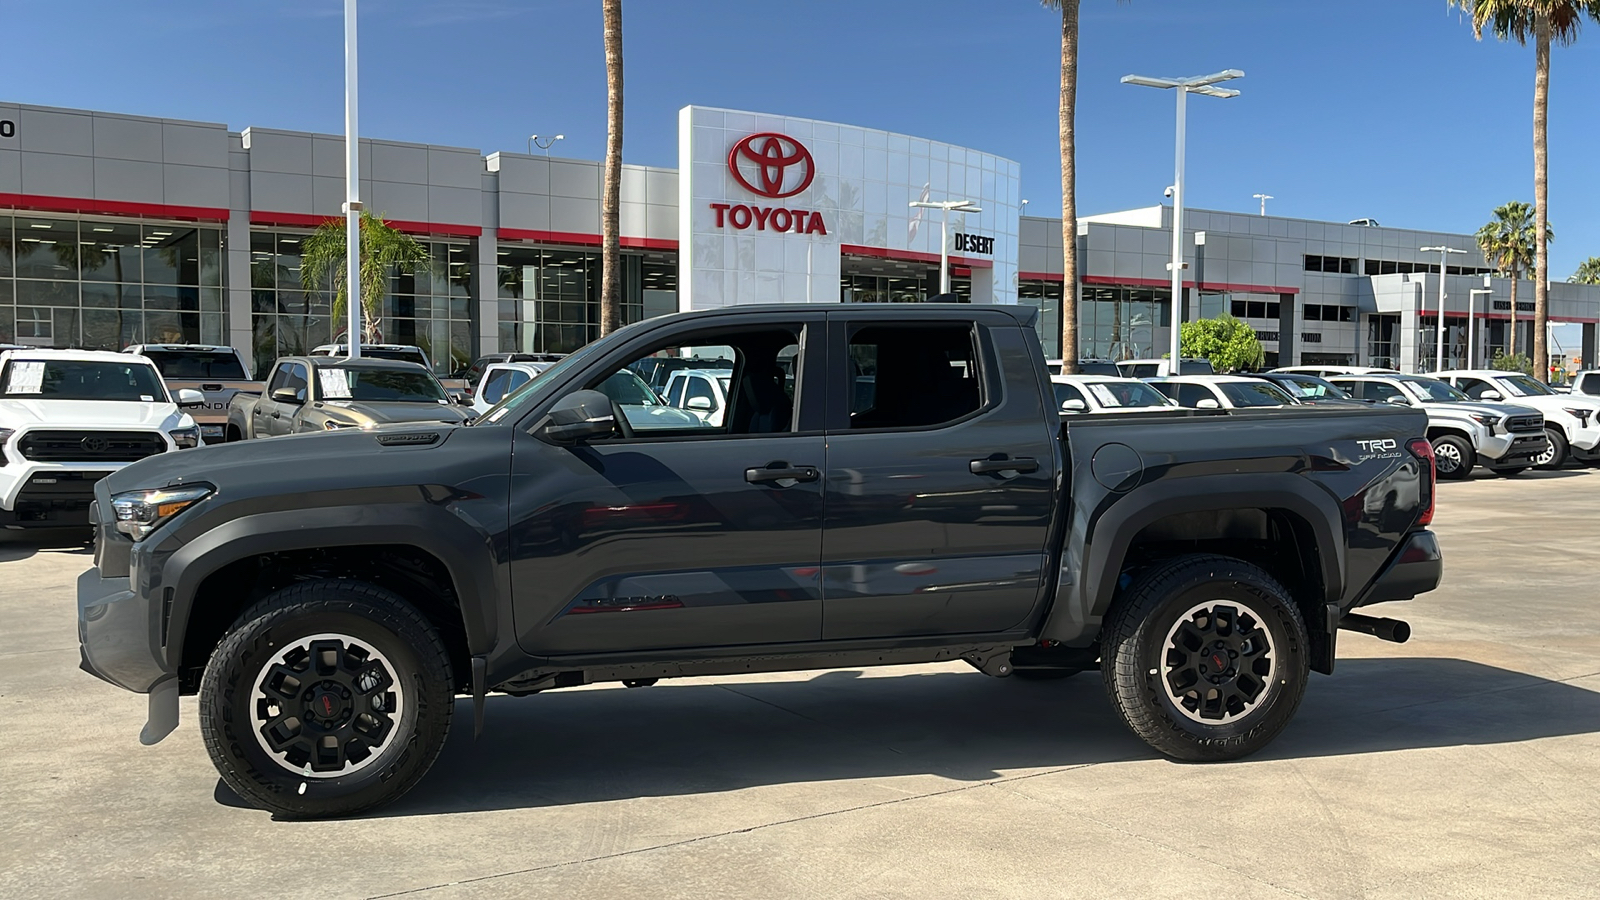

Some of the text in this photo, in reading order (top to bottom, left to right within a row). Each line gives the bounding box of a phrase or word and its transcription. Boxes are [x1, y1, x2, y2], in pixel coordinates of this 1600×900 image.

[710, 203, 827, 235] TOYOTA
[955, 233, 994, 254] DESERT
[1356, 439, 1396, 452] TRD
